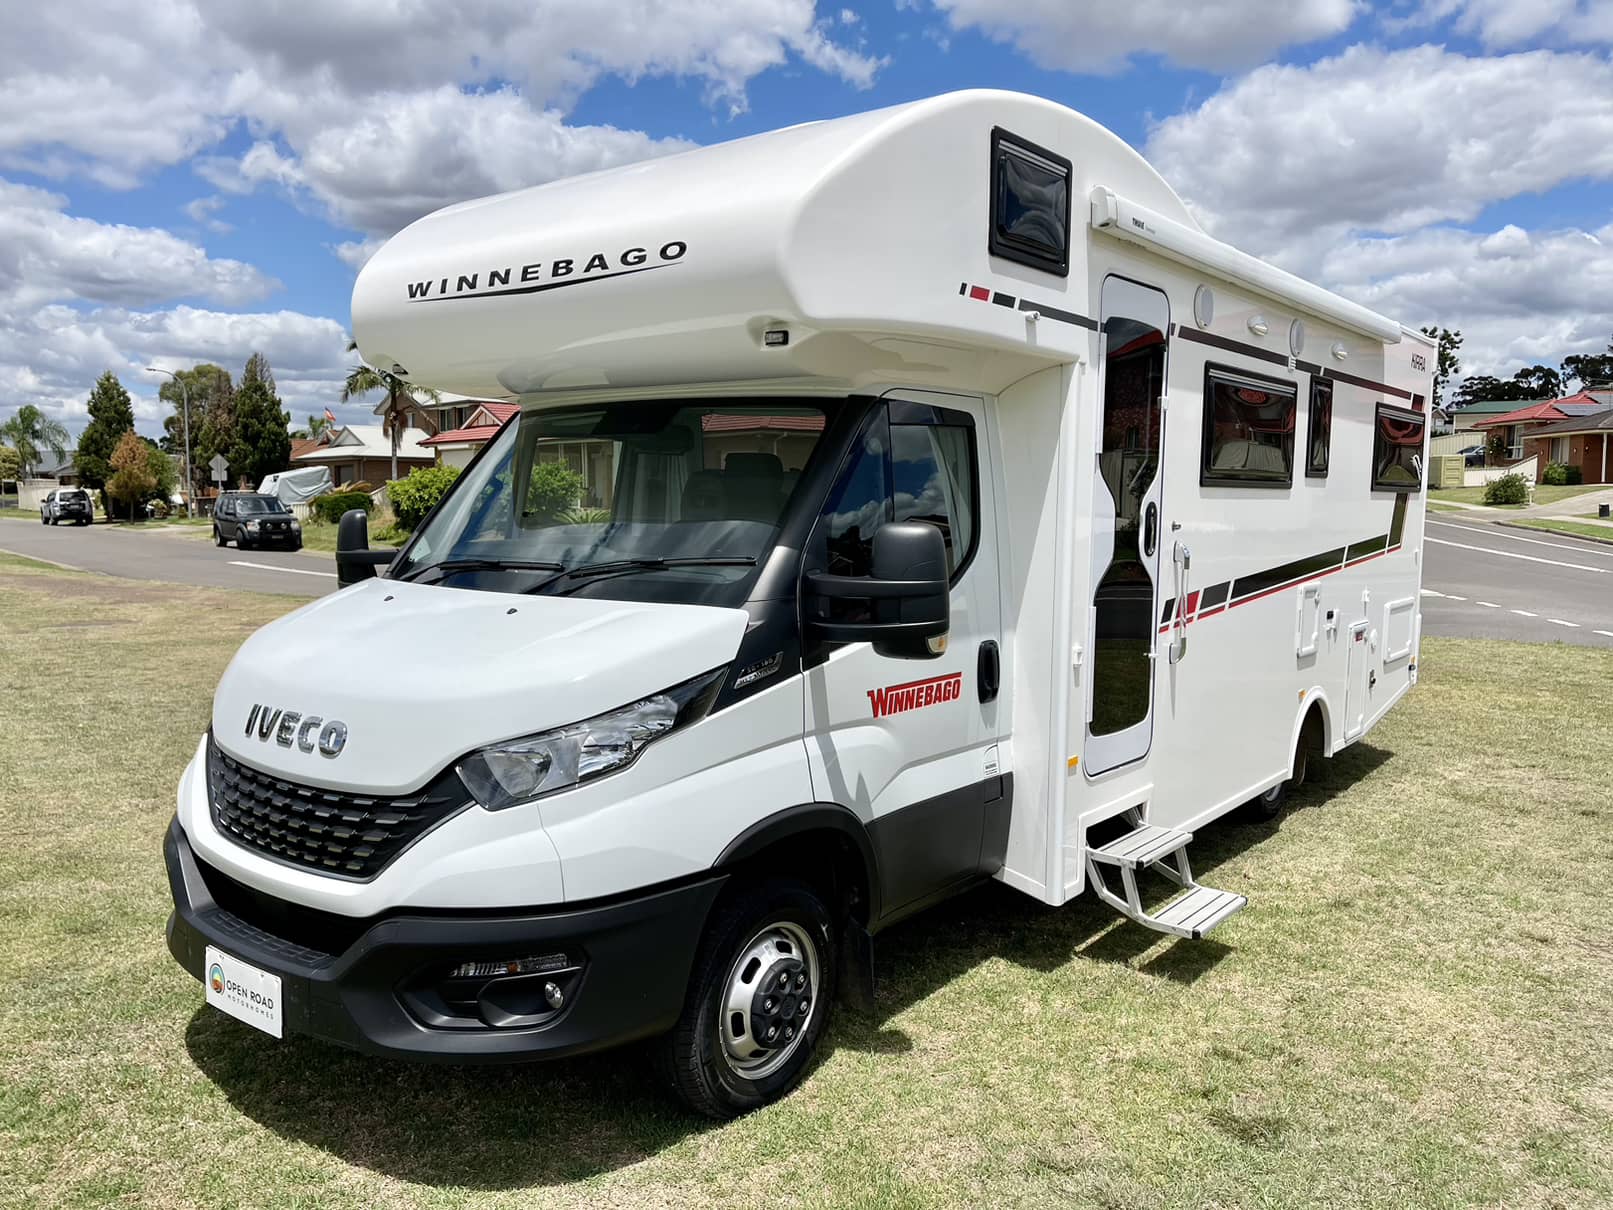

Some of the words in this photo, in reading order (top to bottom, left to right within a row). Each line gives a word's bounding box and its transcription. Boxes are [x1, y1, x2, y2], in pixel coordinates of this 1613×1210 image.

[407, 241, 687, 299] WINNEBAGO
[245, 703, 348, 760] IVECO
[226, 980, 248, 998] OPEN
[250, 991, 274, 1010] ROAD
[227, 994, 274, 1020] MOTORHOMES
